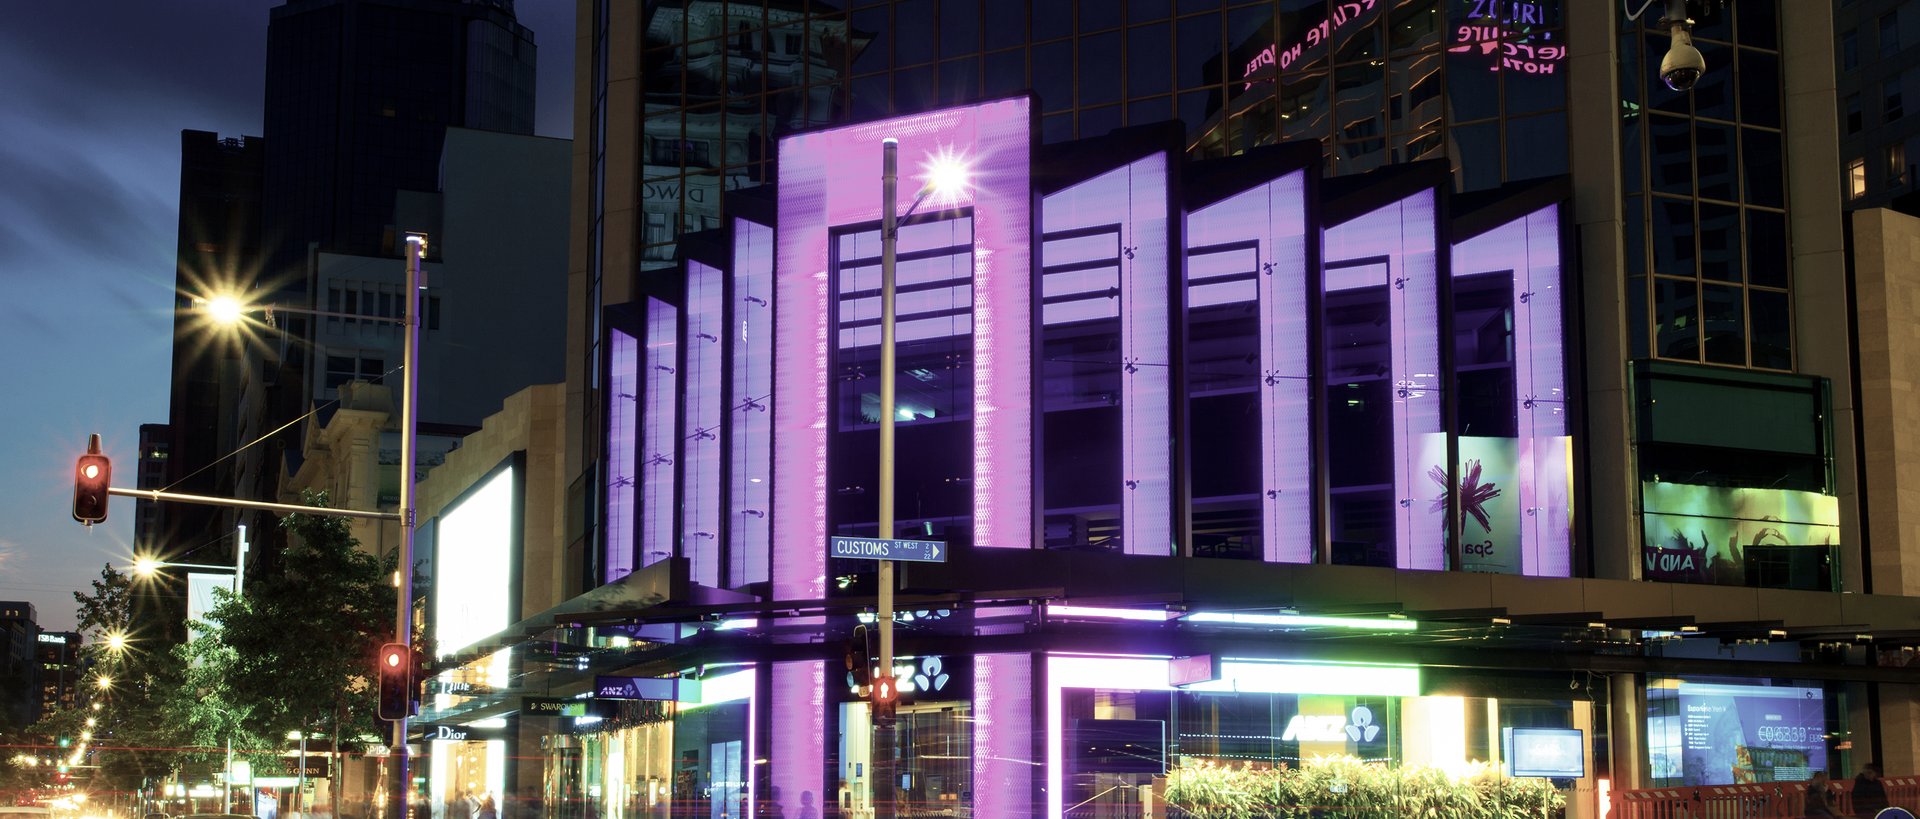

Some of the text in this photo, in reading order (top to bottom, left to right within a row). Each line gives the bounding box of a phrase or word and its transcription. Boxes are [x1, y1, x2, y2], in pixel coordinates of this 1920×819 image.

[837, 541, 918, 556] CUSTOMS ST WEST
[50, 635, 66, 644] Bank
[600, 687, 623, 695] ANZ
[437, 726, 467, 740] Dior
[1282, 715, 1347, 741] ANZ
